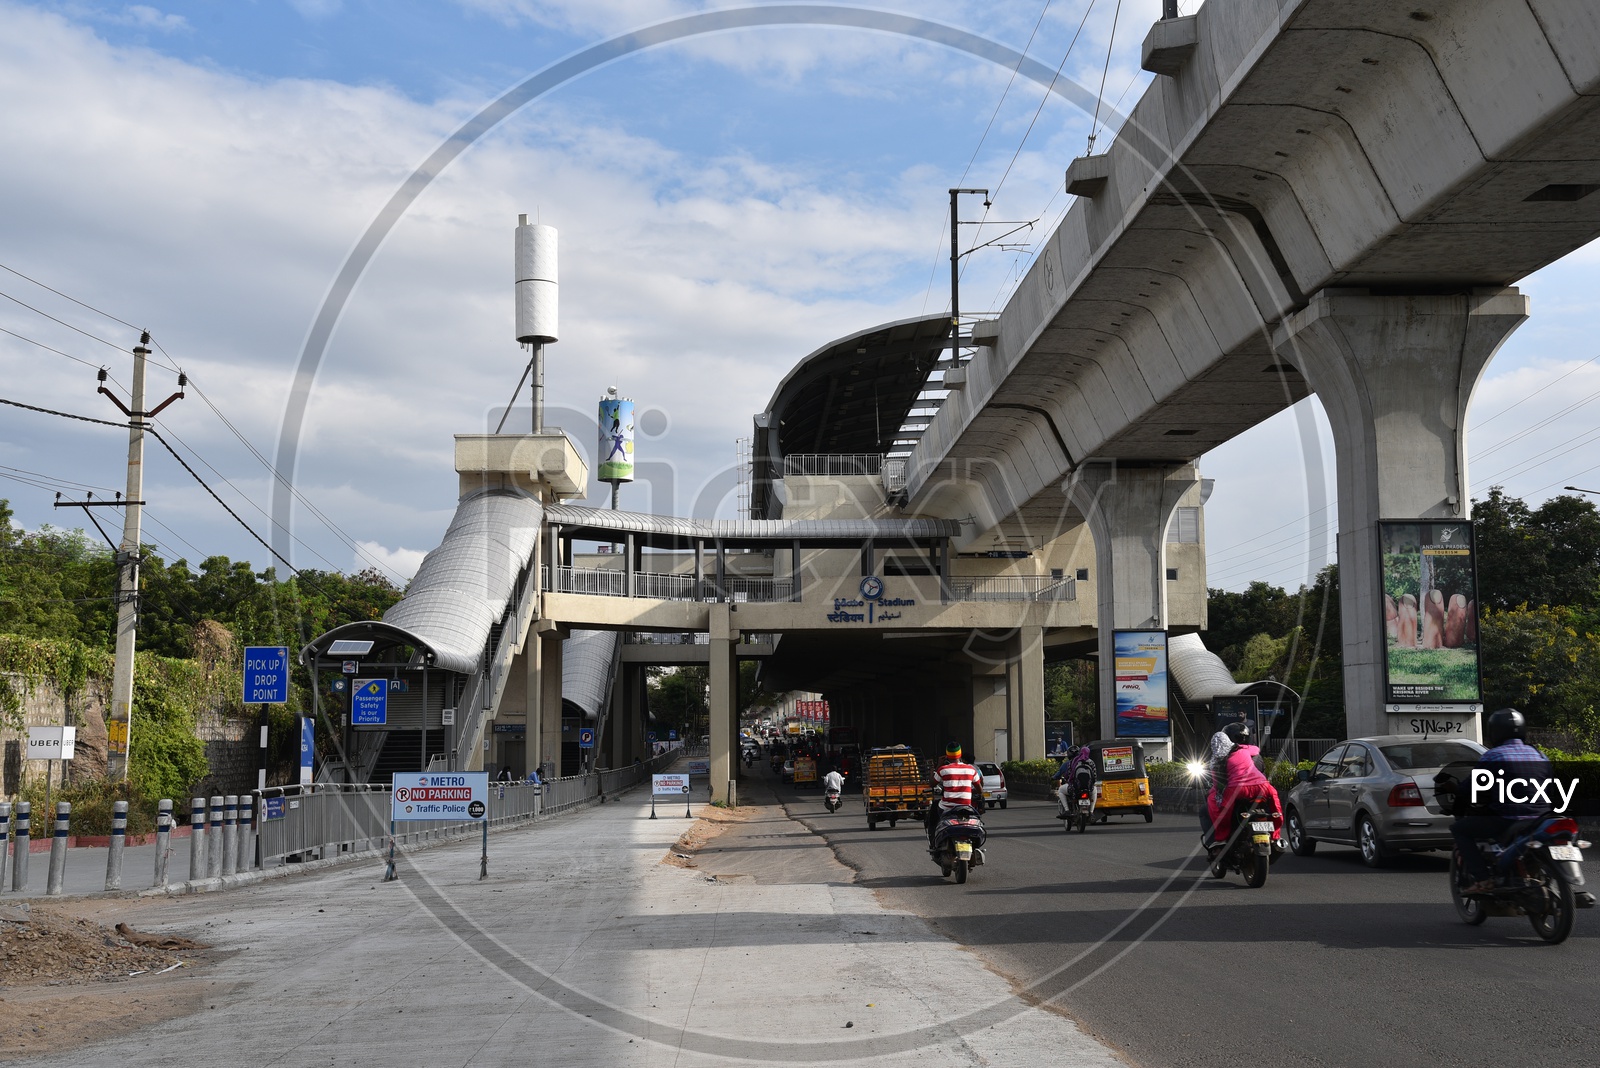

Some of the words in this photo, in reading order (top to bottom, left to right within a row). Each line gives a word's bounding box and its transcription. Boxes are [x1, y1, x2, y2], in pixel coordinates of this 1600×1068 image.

[878, 598, 915, 606] Stadium
[827, 611, 864, 622] स्टेडियम
[248, 660, 266, 670] PICK
[268, 660, 280, 670] UP
[254, 674, 277, 686] DROP
[253, 688, 278, 700] POINT
[431, 776, 464, 786] METRO
[412, 790, 426, 798] NO
[428, 790, 470, 798] PARKING
